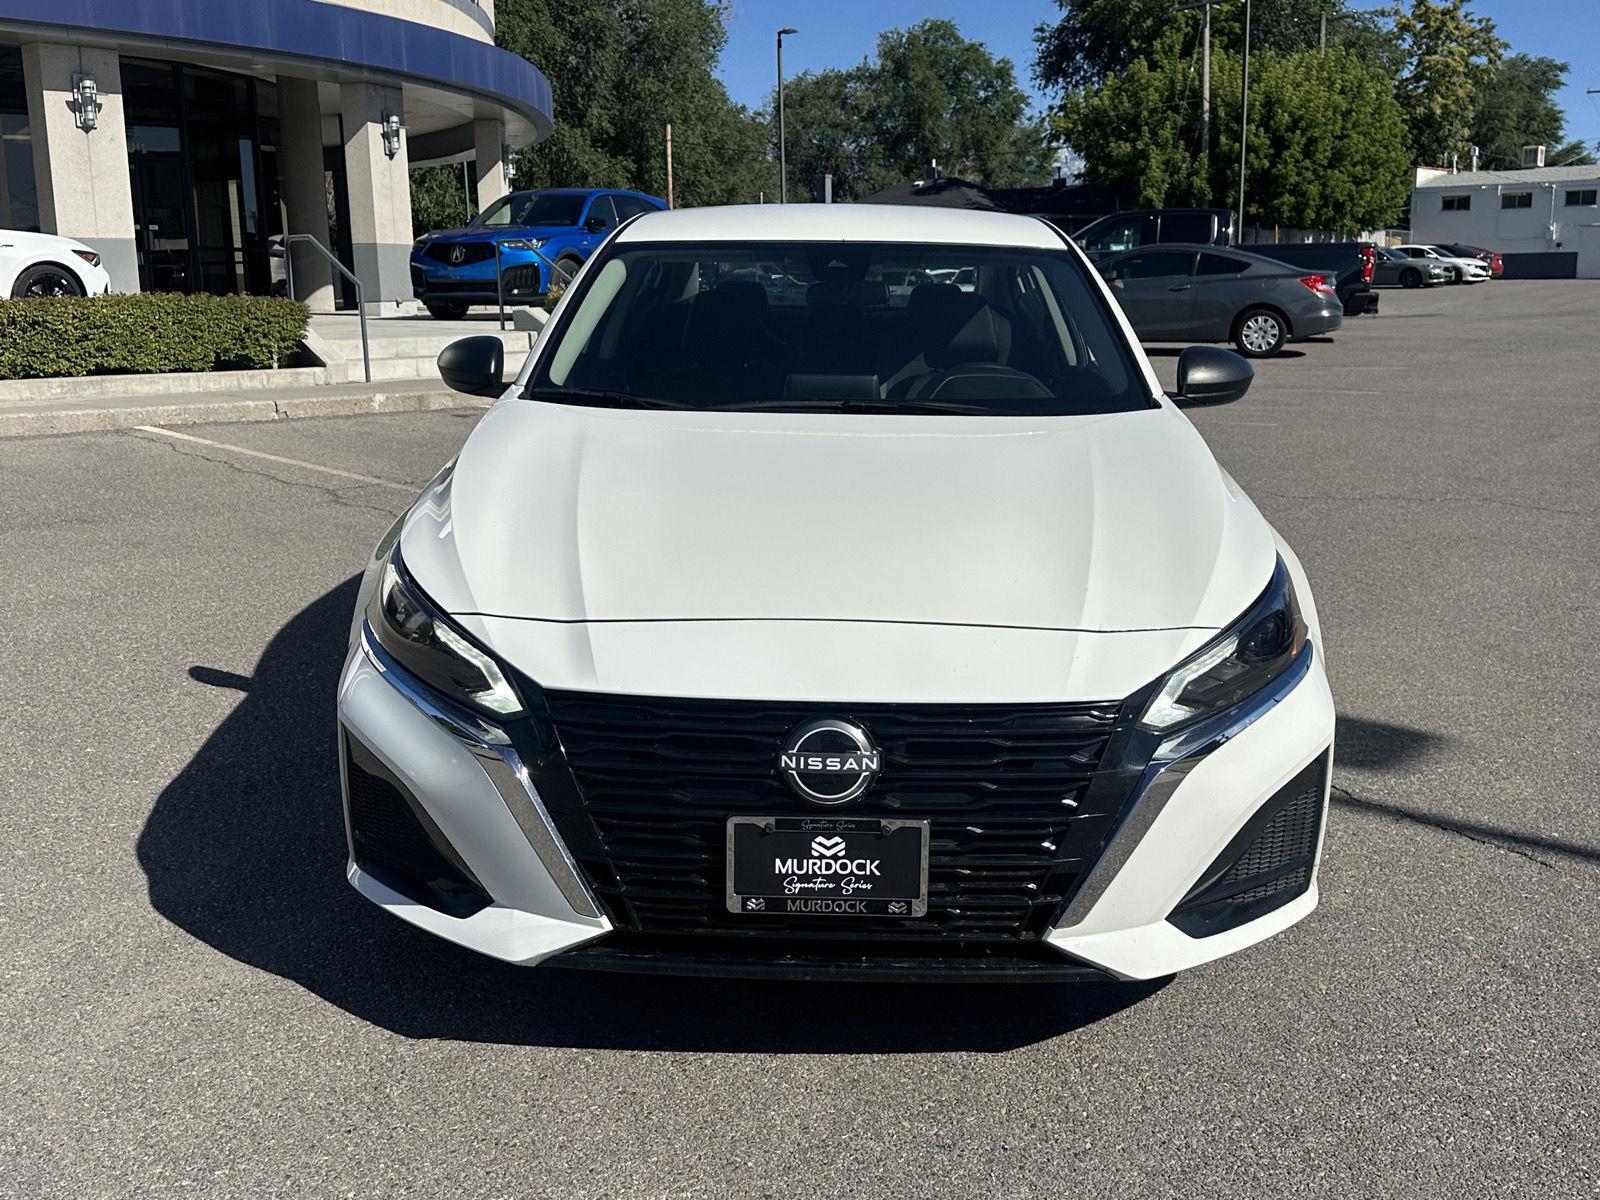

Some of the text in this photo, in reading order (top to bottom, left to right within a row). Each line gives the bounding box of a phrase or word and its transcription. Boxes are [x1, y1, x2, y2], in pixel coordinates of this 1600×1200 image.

[781, 755, 878, 770] NISSAN
[775, 858, 881, 876] MURDOCK
[783, 876, 873, 895] Signature Series
[787, 899, 867, 913] MURDOCK
